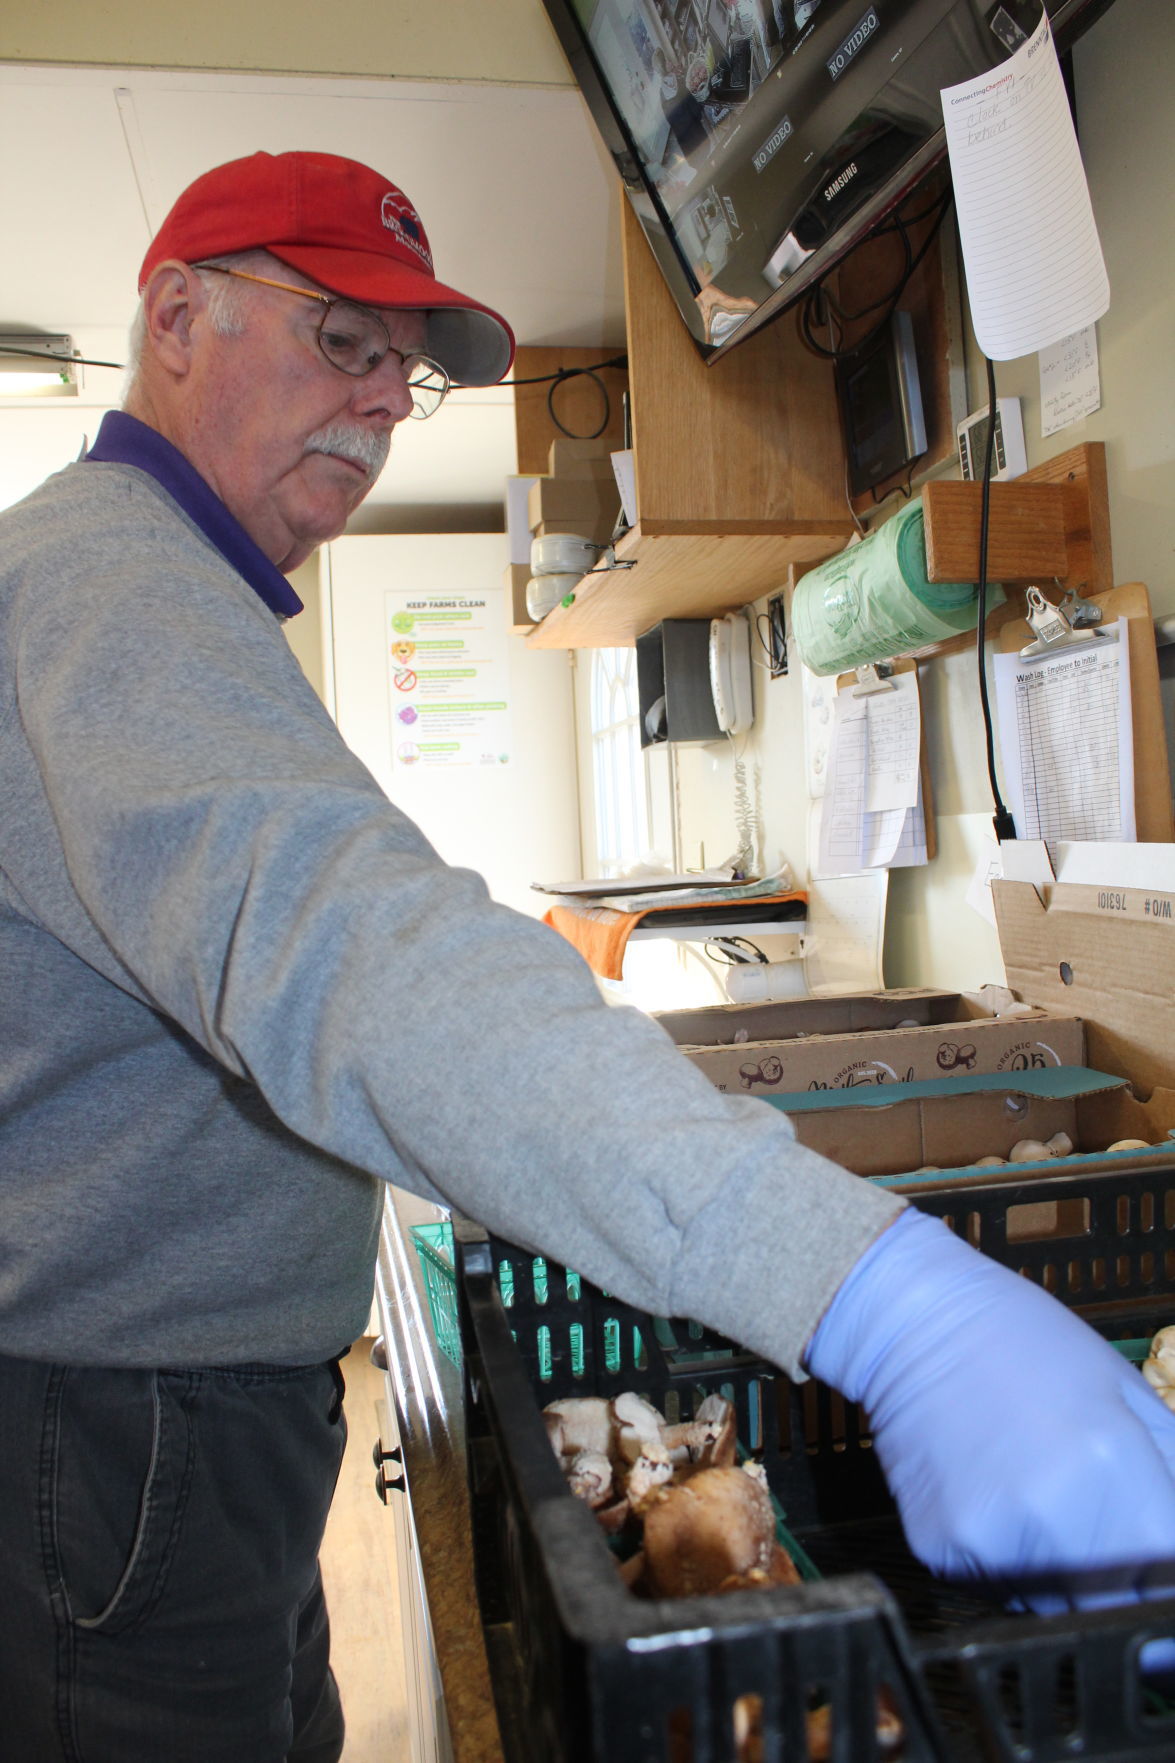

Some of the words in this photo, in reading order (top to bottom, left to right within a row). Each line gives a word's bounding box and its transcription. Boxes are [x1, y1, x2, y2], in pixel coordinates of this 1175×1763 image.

[828, 54, 845, 77] NO
[844, 14, 877, 57] VIDEO
[753, 151, 767, 169] NO
[766, 121, 791, 154] VIDEO
[824, 162, 858, 202] SAMSUNG
[406, 601, 427, 609] KEEP
[429, 600, 457, 608] FARMS
[458, 600, 486, 608] CLEAN
[1016, 671, 1034, 683] Wash
[1034, 669, 1044, 679] Log
[1047, 663, 1073, 676] Employee
[1074, 659, 1081, 667] to
[1081, 654, 1098, 666] Initial
[1097, 891, 1127, 911] 763101
[1152, 899, 1172, 918] W/O
[997, 1041, 1031, 1071] ORGANIC
[834, 1060, 867, 1084] ORGANIC
